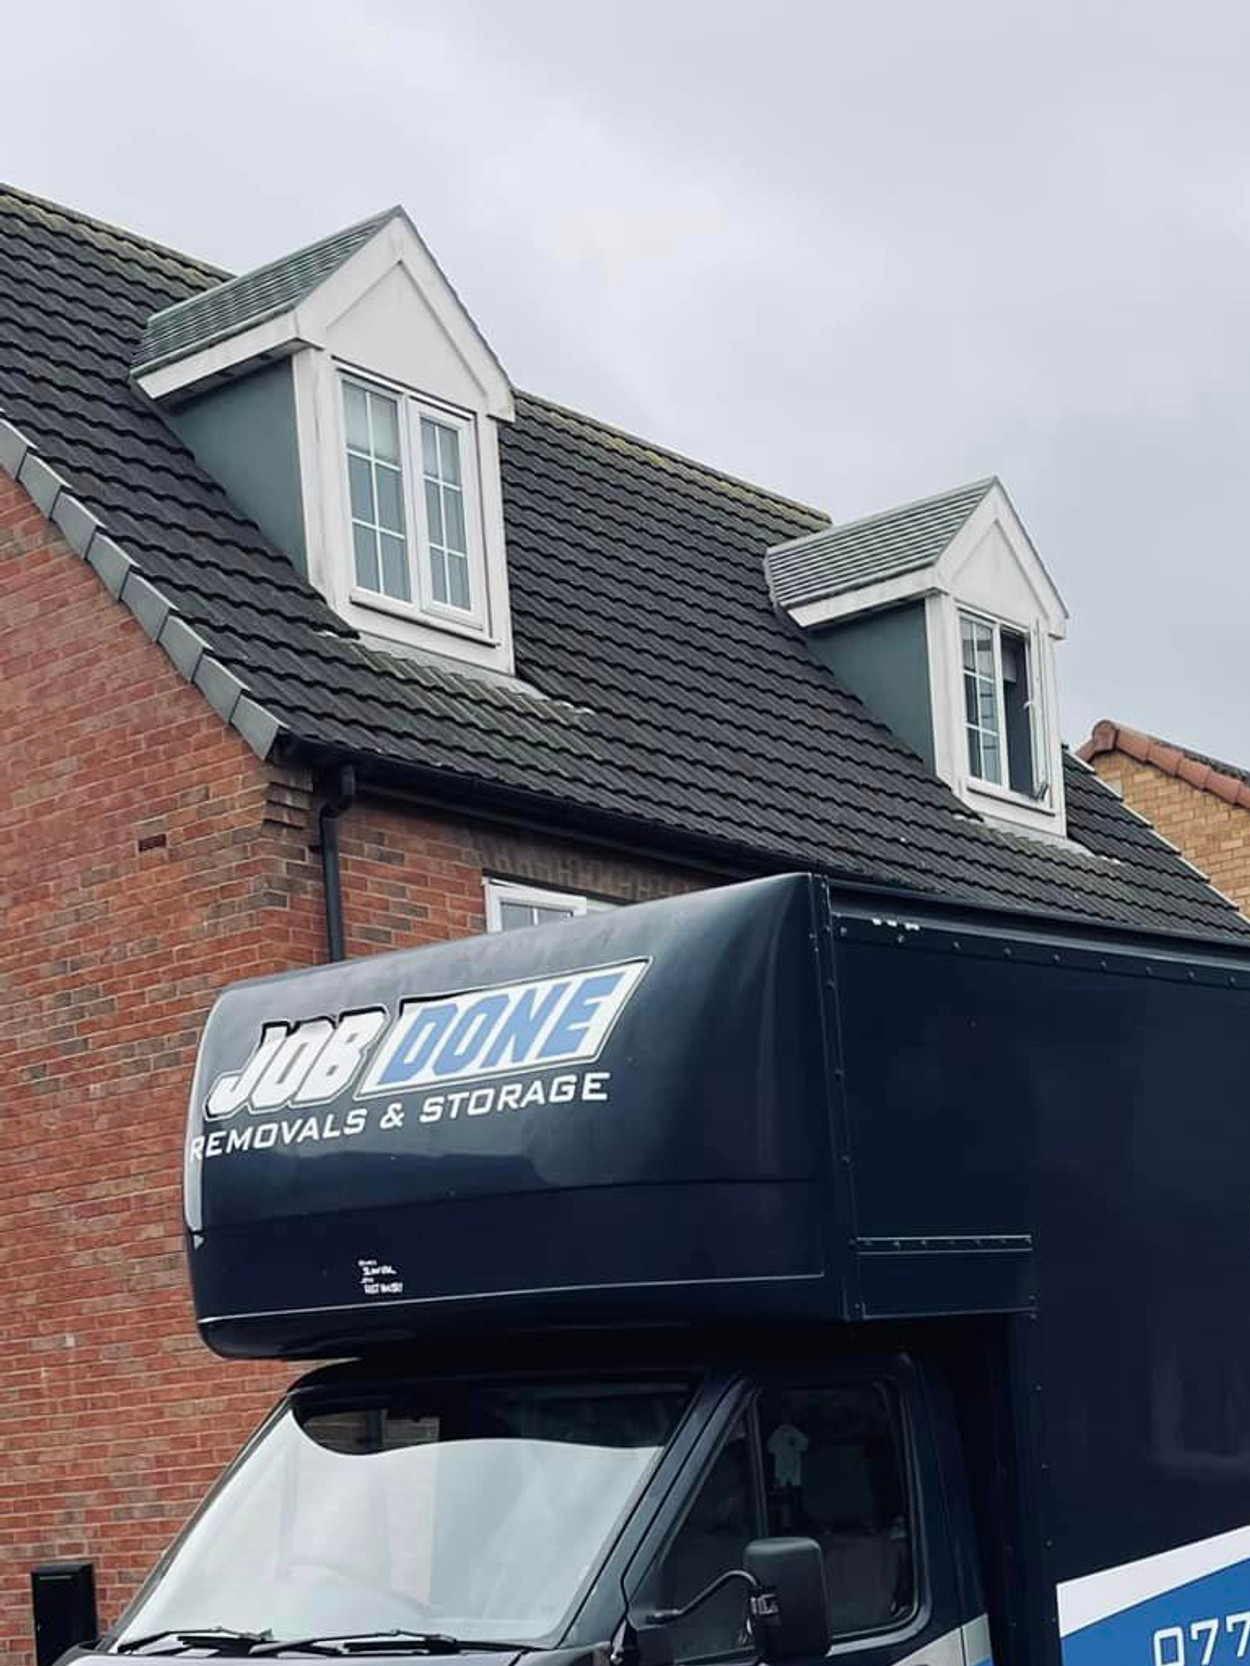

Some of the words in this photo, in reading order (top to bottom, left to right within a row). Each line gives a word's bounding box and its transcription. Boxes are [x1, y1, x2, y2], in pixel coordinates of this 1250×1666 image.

[207, 1011, 386, 1116] JOB
[377, 972, 622, 1085] DONE
[189, 1108, 367, 1160] REMOVALS
[379, 1109, 405, 1130] &
[419, 1072, 612, 1124] STORAGE
